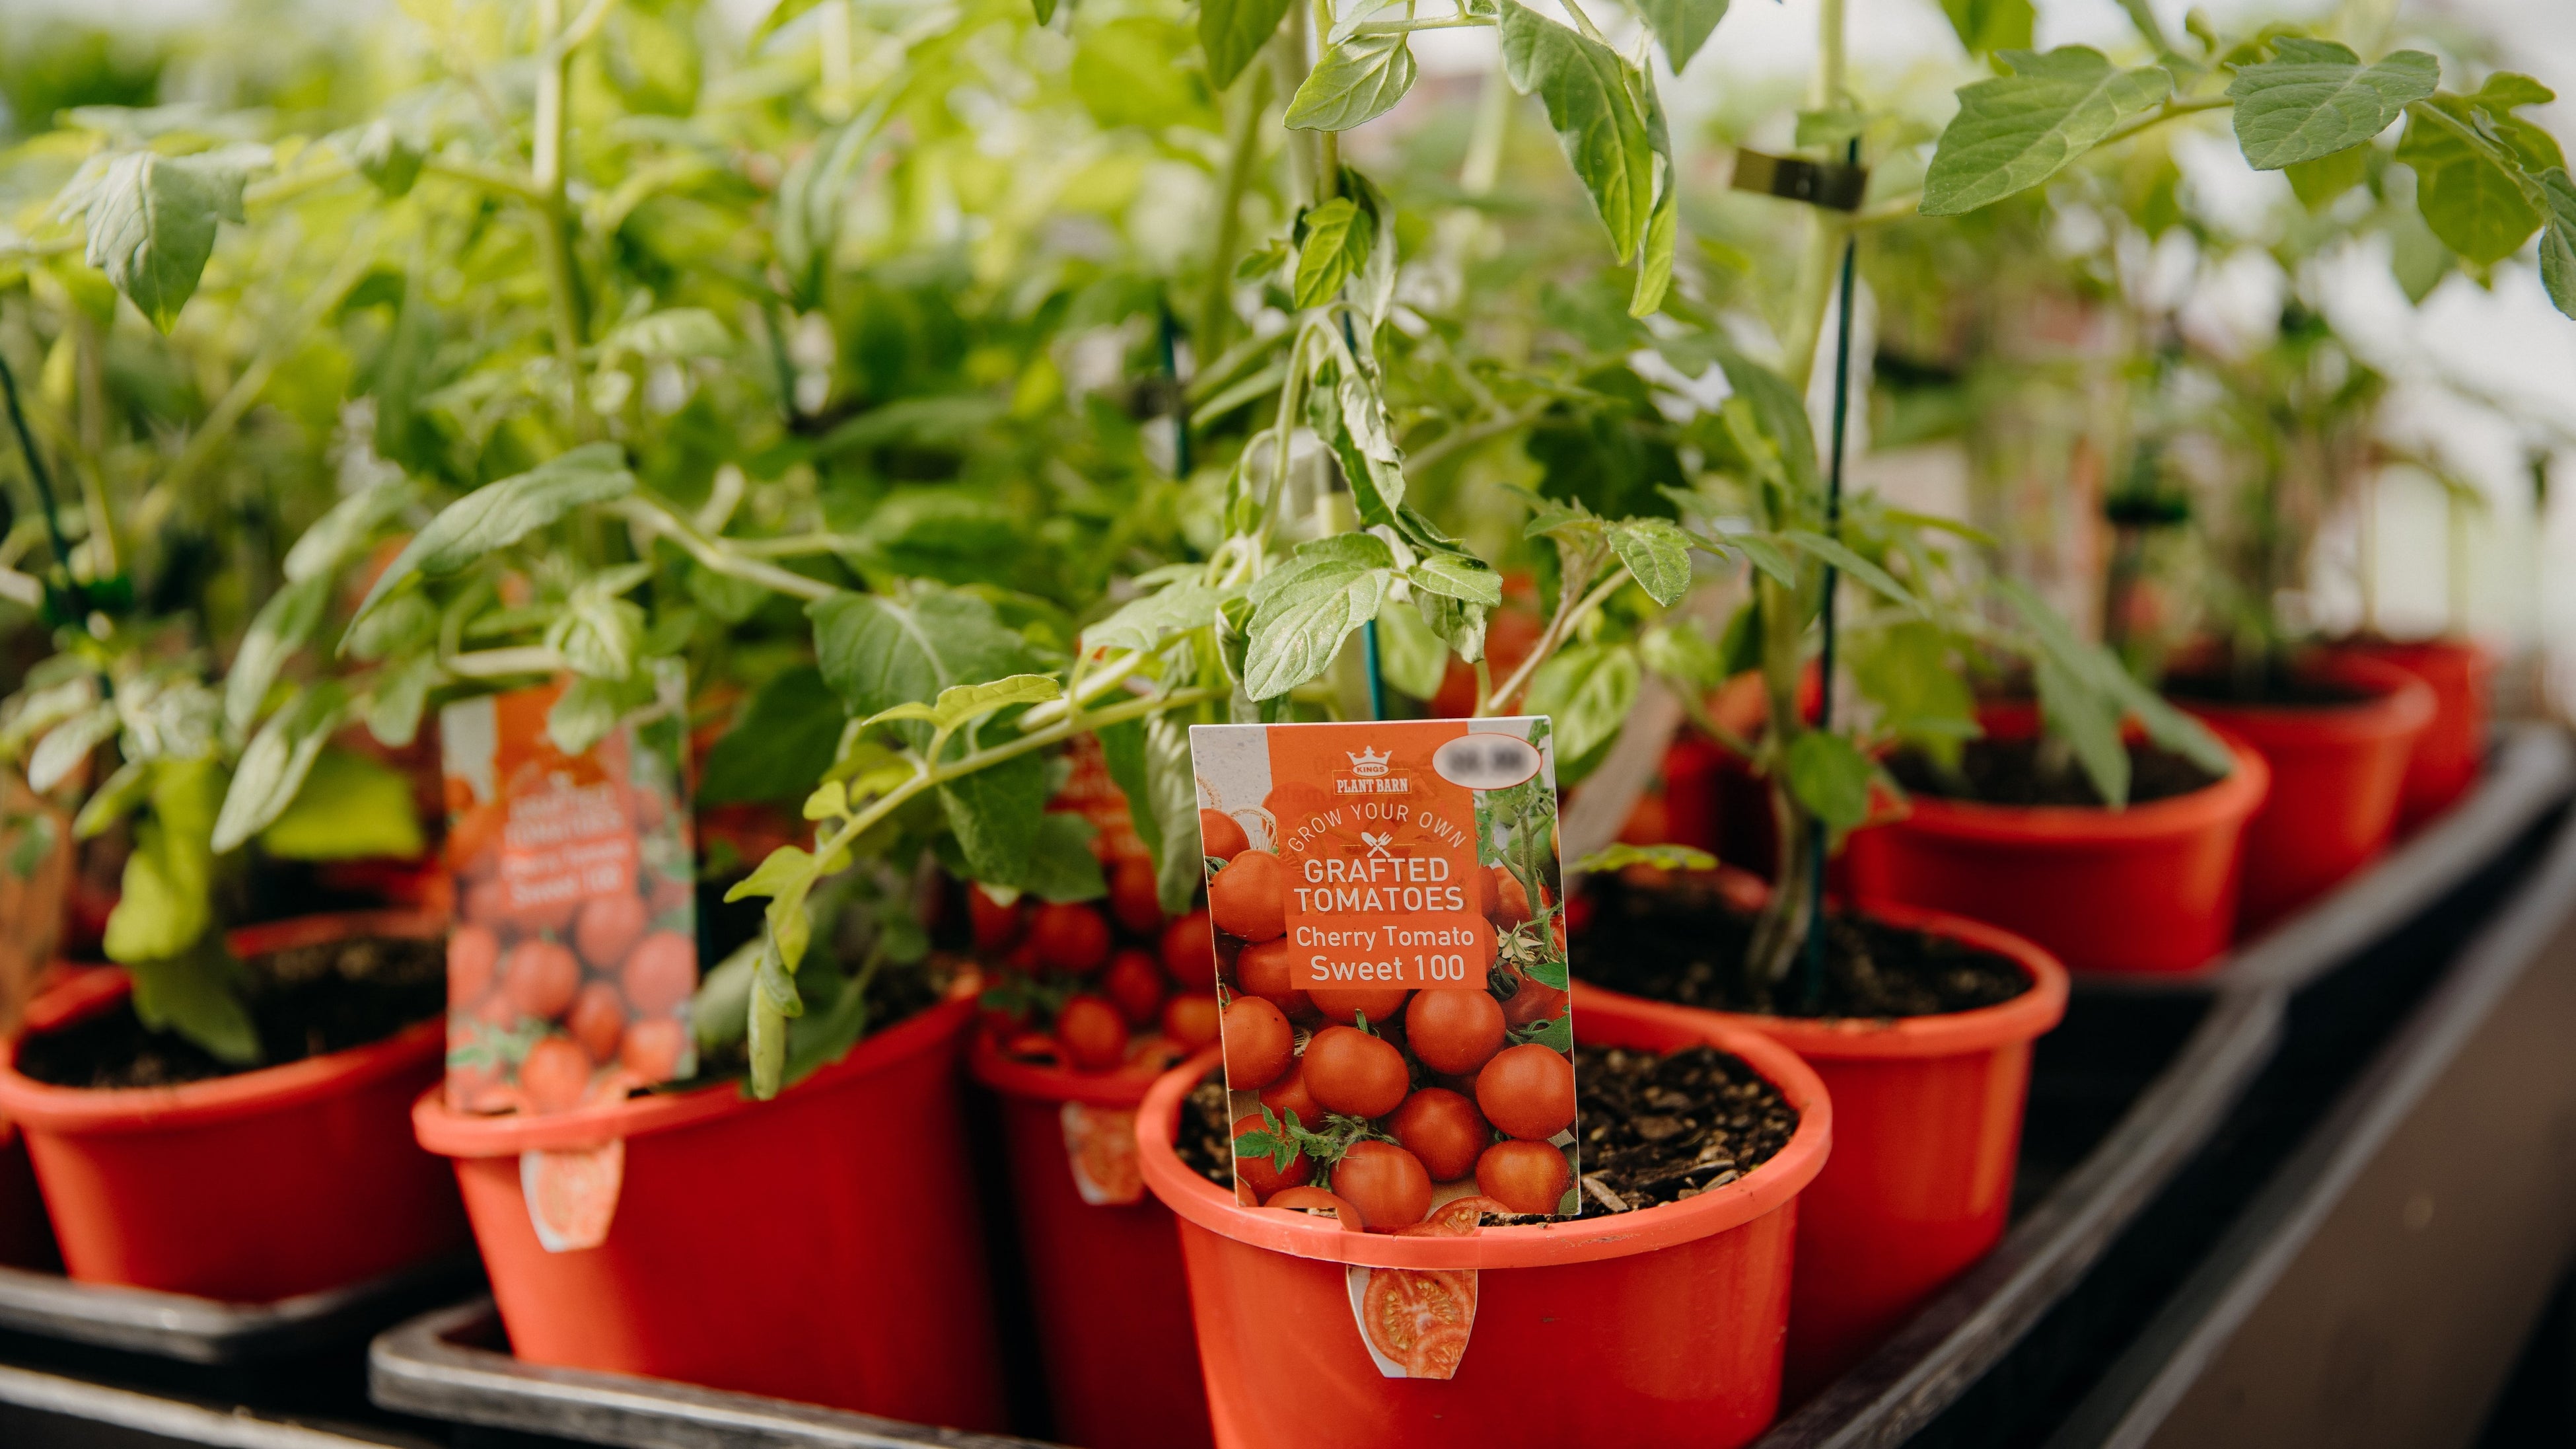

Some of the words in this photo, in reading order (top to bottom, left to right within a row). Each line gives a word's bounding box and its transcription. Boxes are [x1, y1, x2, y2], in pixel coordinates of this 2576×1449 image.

[1336, 779, 1375, 794] PLANT
[1376, 778, 1408, 792] BARN
[1287, 808, 1342, 852] GROW
[1350, 803, 1409, 822] YOUR
[1419, 811, 1467, 848] OWN
[1304, 858, 1449, 883] GRAFTED
[1293, 886, 1464, 912] TOMATOES
[1296, 926, 1377, 951] Cherry
[1382, 926, 1474, 946] Tomato
[1310, 955, 1404, 981] Sweet
[1414, 954, 1465, 981] 100
